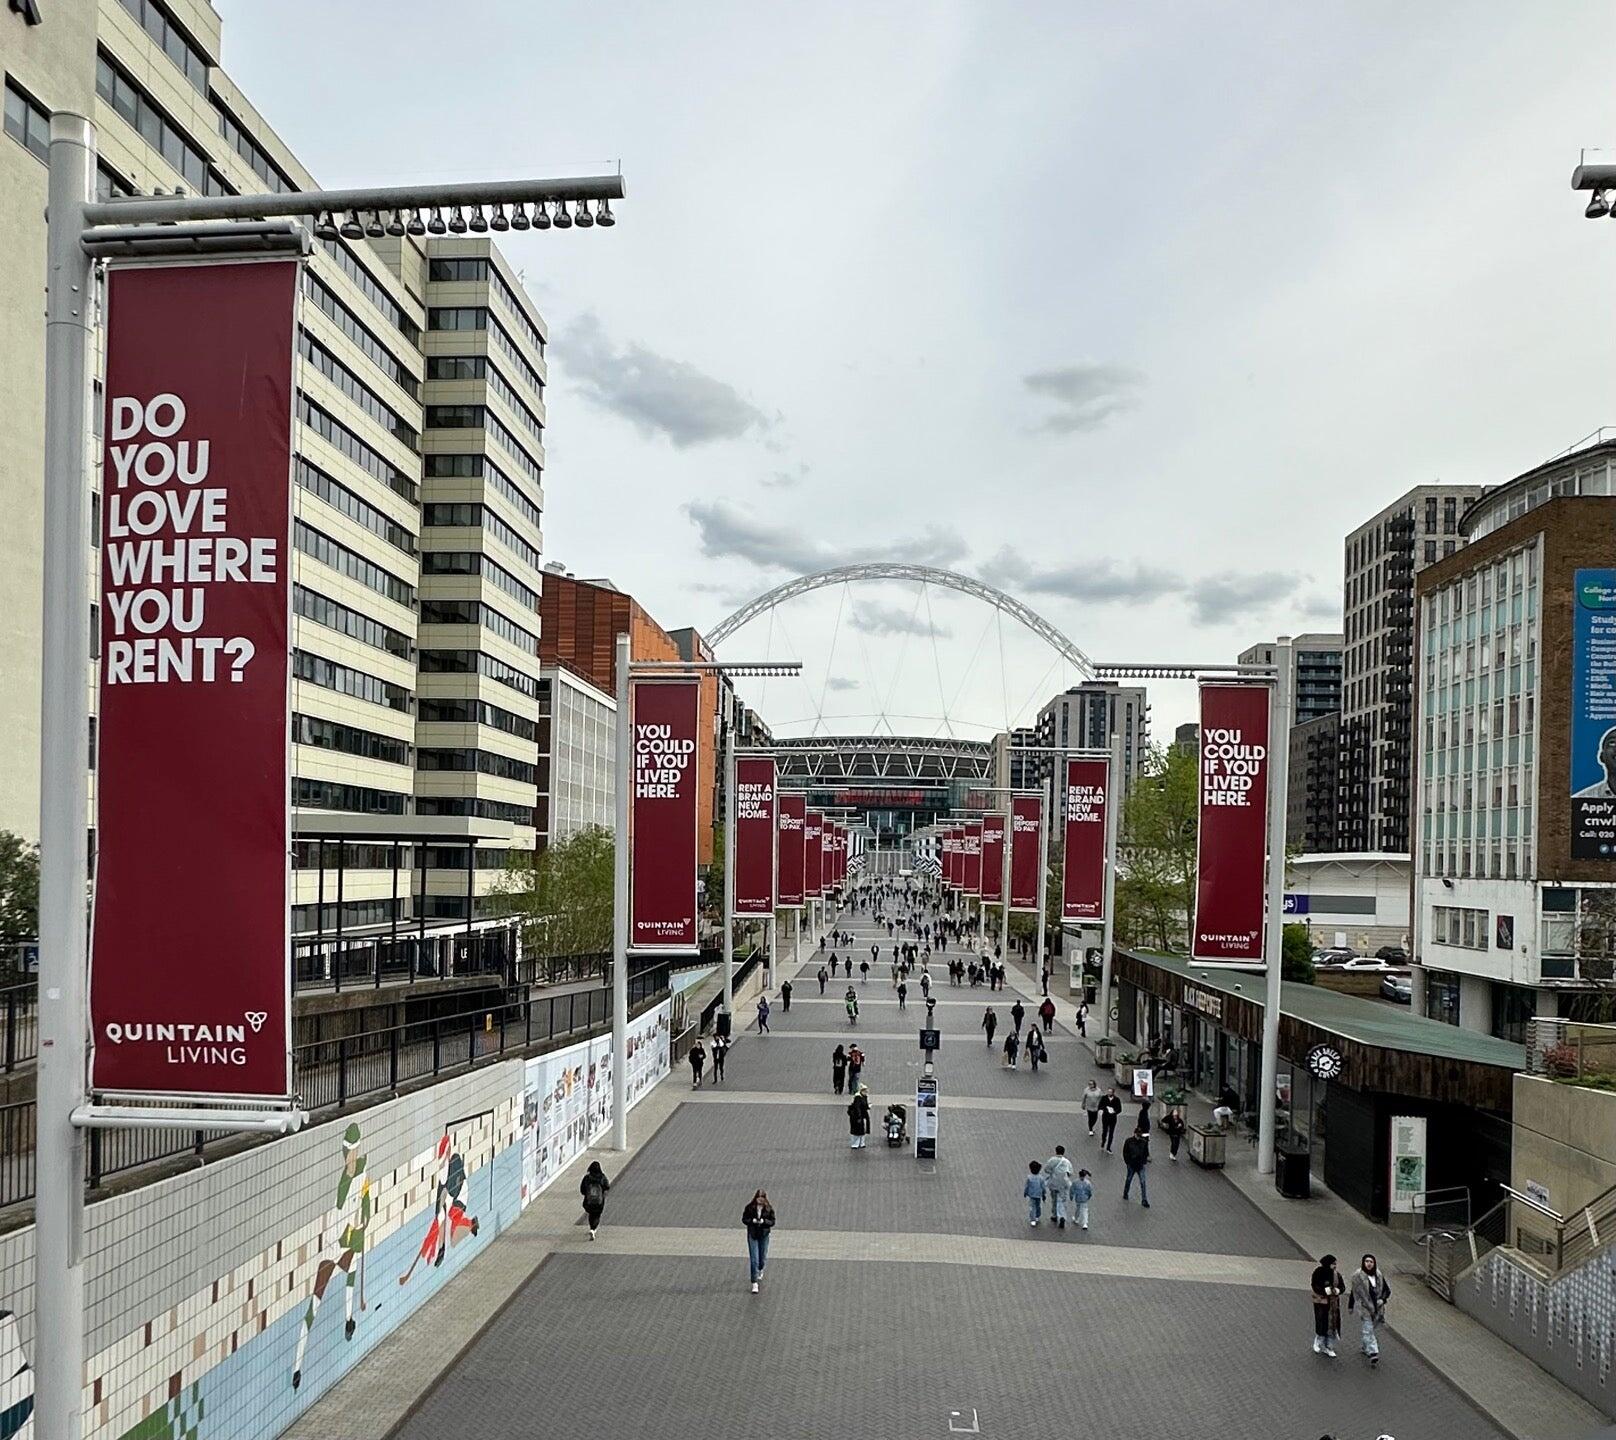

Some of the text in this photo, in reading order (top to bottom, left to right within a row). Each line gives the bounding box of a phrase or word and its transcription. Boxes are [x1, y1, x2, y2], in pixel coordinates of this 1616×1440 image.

[112, 393, 186, 441] DO
[110, 440, 209, 488] YOU
[109, 488, 227, 537] LOVE
[107, 537, 277, 586] WHERE
[107, 587, 204, 635] YOU
[107, 636, 255, 684] RENT?
[636, 724, 671, 739] YOU
[1204, 728, 1241, 744] YOU
[636, 739, 695, 754] COULD
[1204, 744, 1266, 760] COULD
[636, 754, 688, 769] IF YOU
[1204, 759, 1260, 776] IF YOU
[636, 769, 682, 783] LIVED
[1204, 775, 1253, 791] LIVED
[636, 783, 680, 798] HERE.
[738, 783, 772, 792] RENT A
[1069, 785, 1104, 795] RENT A
[738, 792, 773, 801] BRAND
[1069, 794, 1105, 804] BRAND
[1203, 790, 1251, 806] HERE.
[738, 801, 761, 810] NEW
[1068, 803, 1092, 813] NEW
[1580, 802, 1615, 814] Apply
[738, 809, 771, 819] HOME.
[1068, 812, 1102, 822] HOME.
[637, 921, 684, 930] QUINTAIN
[1200, 933, 1250, 942] QUINTAIN
[1220, 942, 1250, 950] LIVING
[105, 1022, 245, 1044] QUINTAIN
[167, 1046, 247, 1065] LIVING
